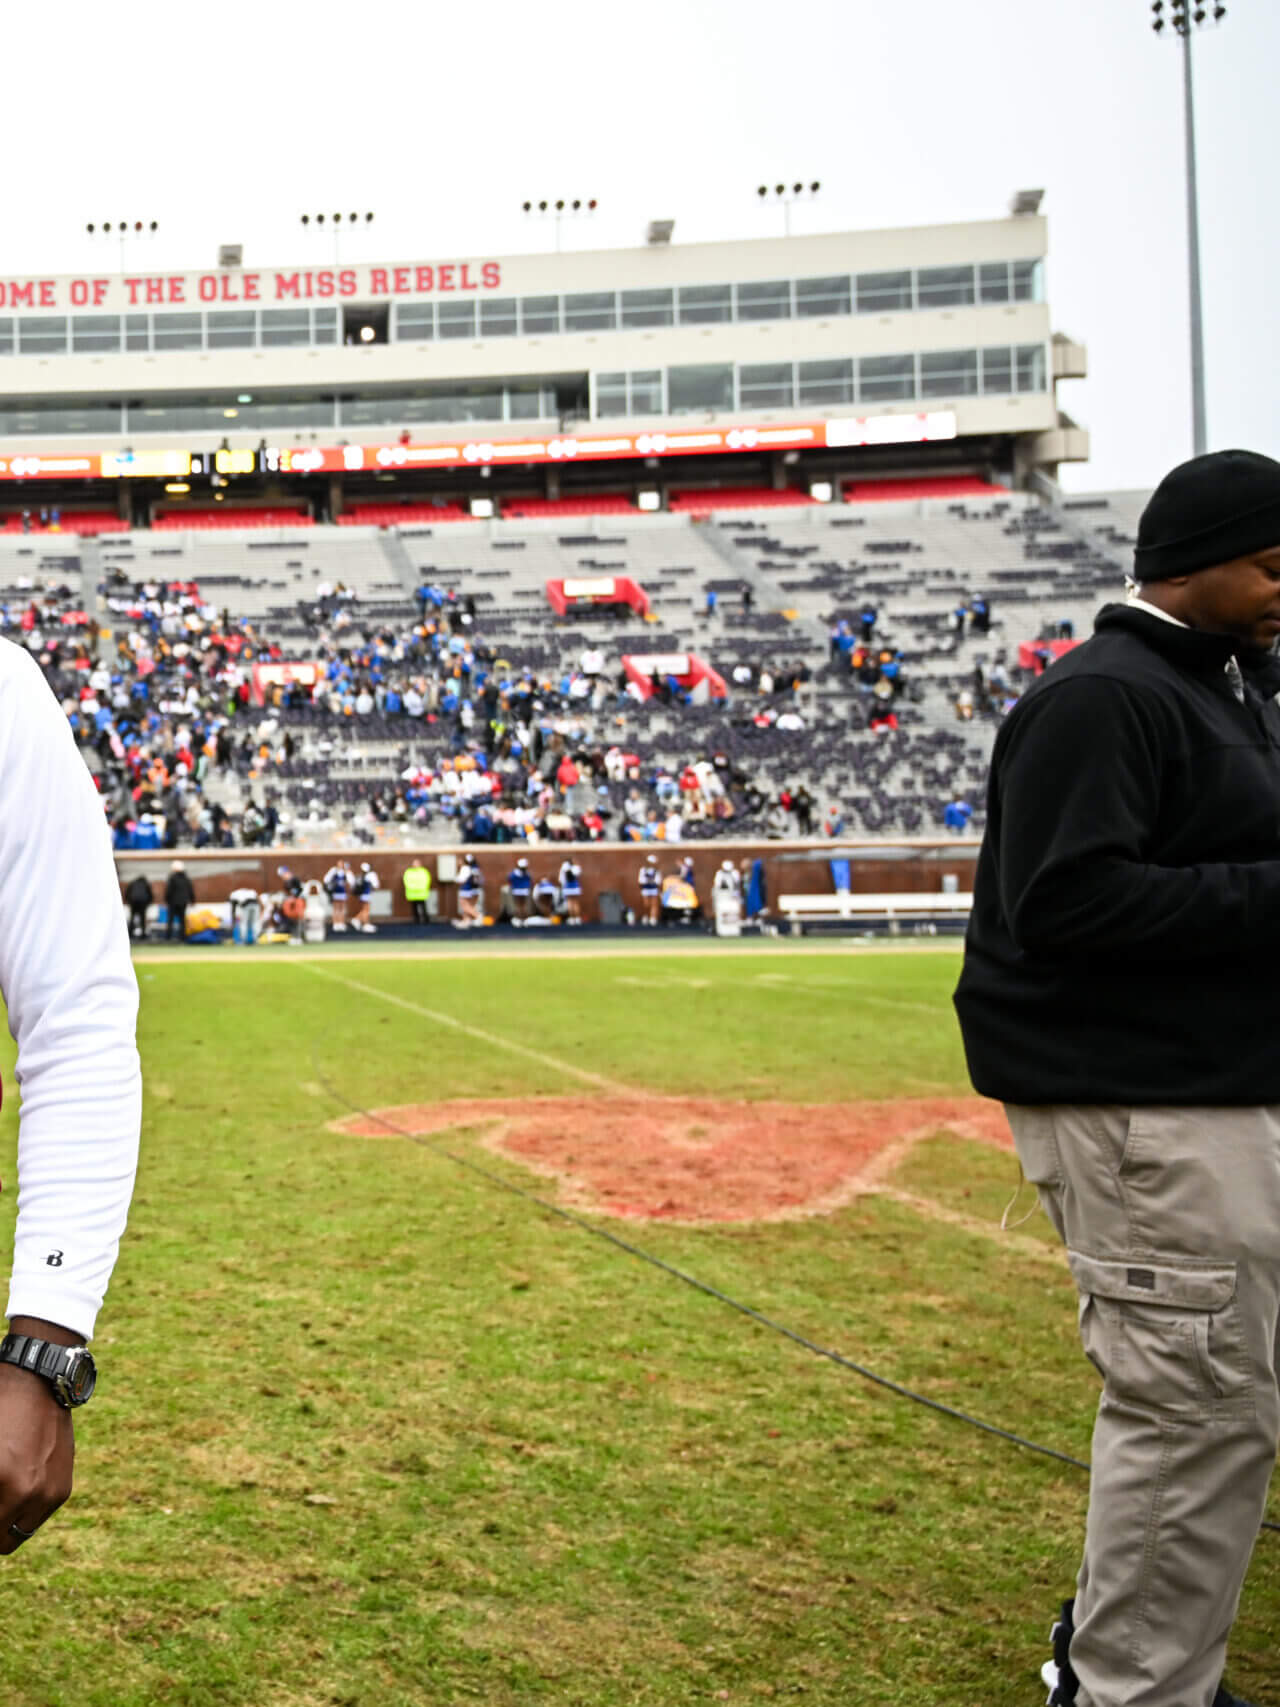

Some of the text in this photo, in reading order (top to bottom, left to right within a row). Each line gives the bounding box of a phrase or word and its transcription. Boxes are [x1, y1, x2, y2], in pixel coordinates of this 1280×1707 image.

[70, 279, 110, 306] OF
[123, 276, 187, 305] THE
[199, 274, 261, 302] OLE
[274, 270, 358, 299] MISS
[369, 262, 501, 295] REBELS
